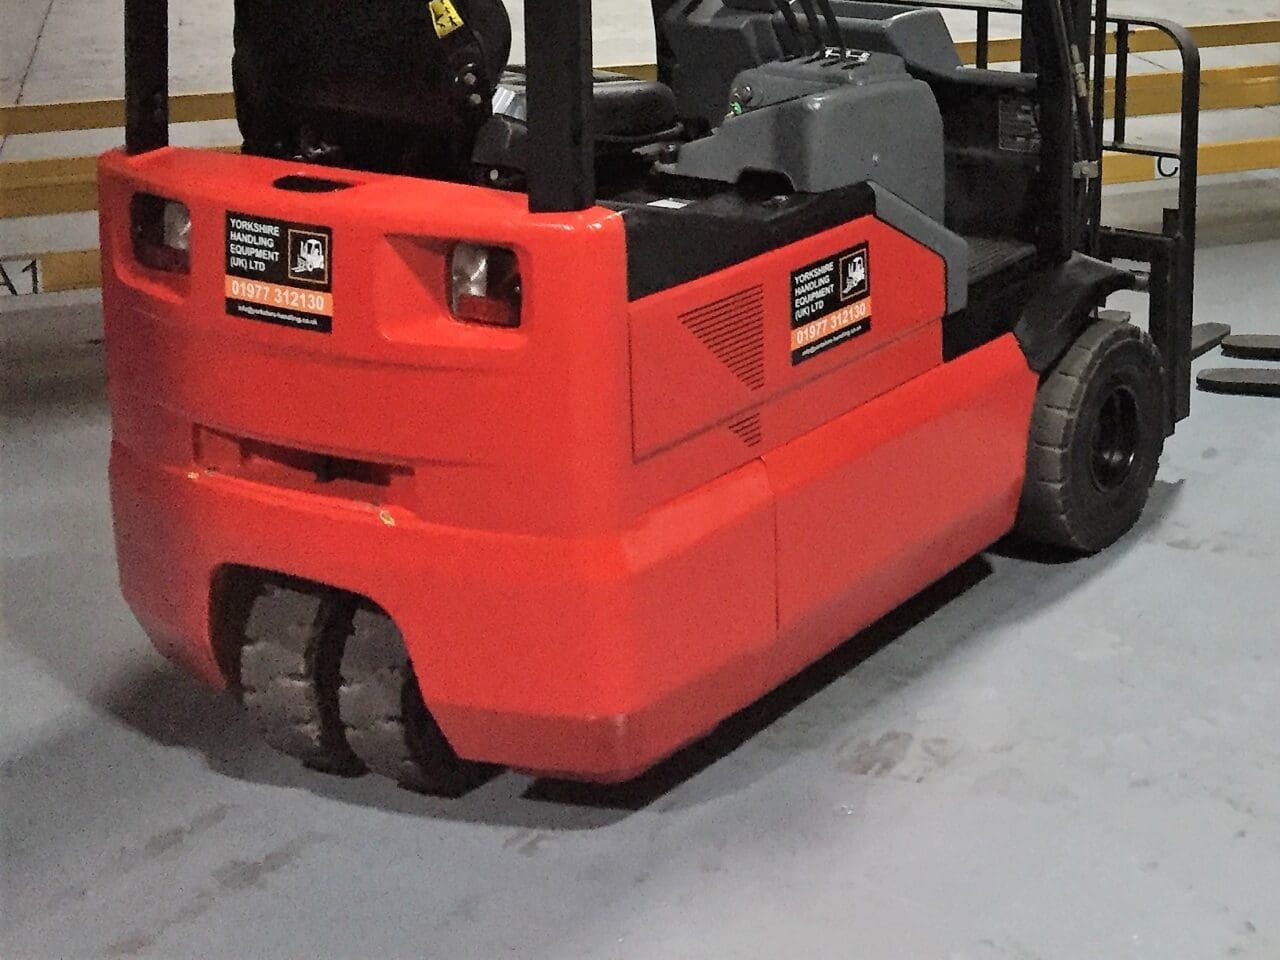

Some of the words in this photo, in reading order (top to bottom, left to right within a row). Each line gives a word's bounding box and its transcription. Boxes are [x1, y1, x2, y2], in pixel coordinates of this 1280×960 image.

[230, 218, 280, 237] YORKSHIRE
[230, 231, 275, 248] HANDLING
[230, 244, 280, 262] EQUIPMENT
[230, 257, 248, 271] (UK)
[249, 260, 266, 271] LTD
[794, 261, 834, 285] YORKSHIRE
[231, 280, 269, 301] 01977
[274, 288, 324, 311] 312130
[795, 275, 830, 296] HANDLING
[795, 284, 834, 308] EQUIPMENT
[795, 306, 810, 321] (UK)
[811, 300, 824, 313] LTD
[796, 319, 828, 344] 01977
[831, 303, 866, 329] 312130
